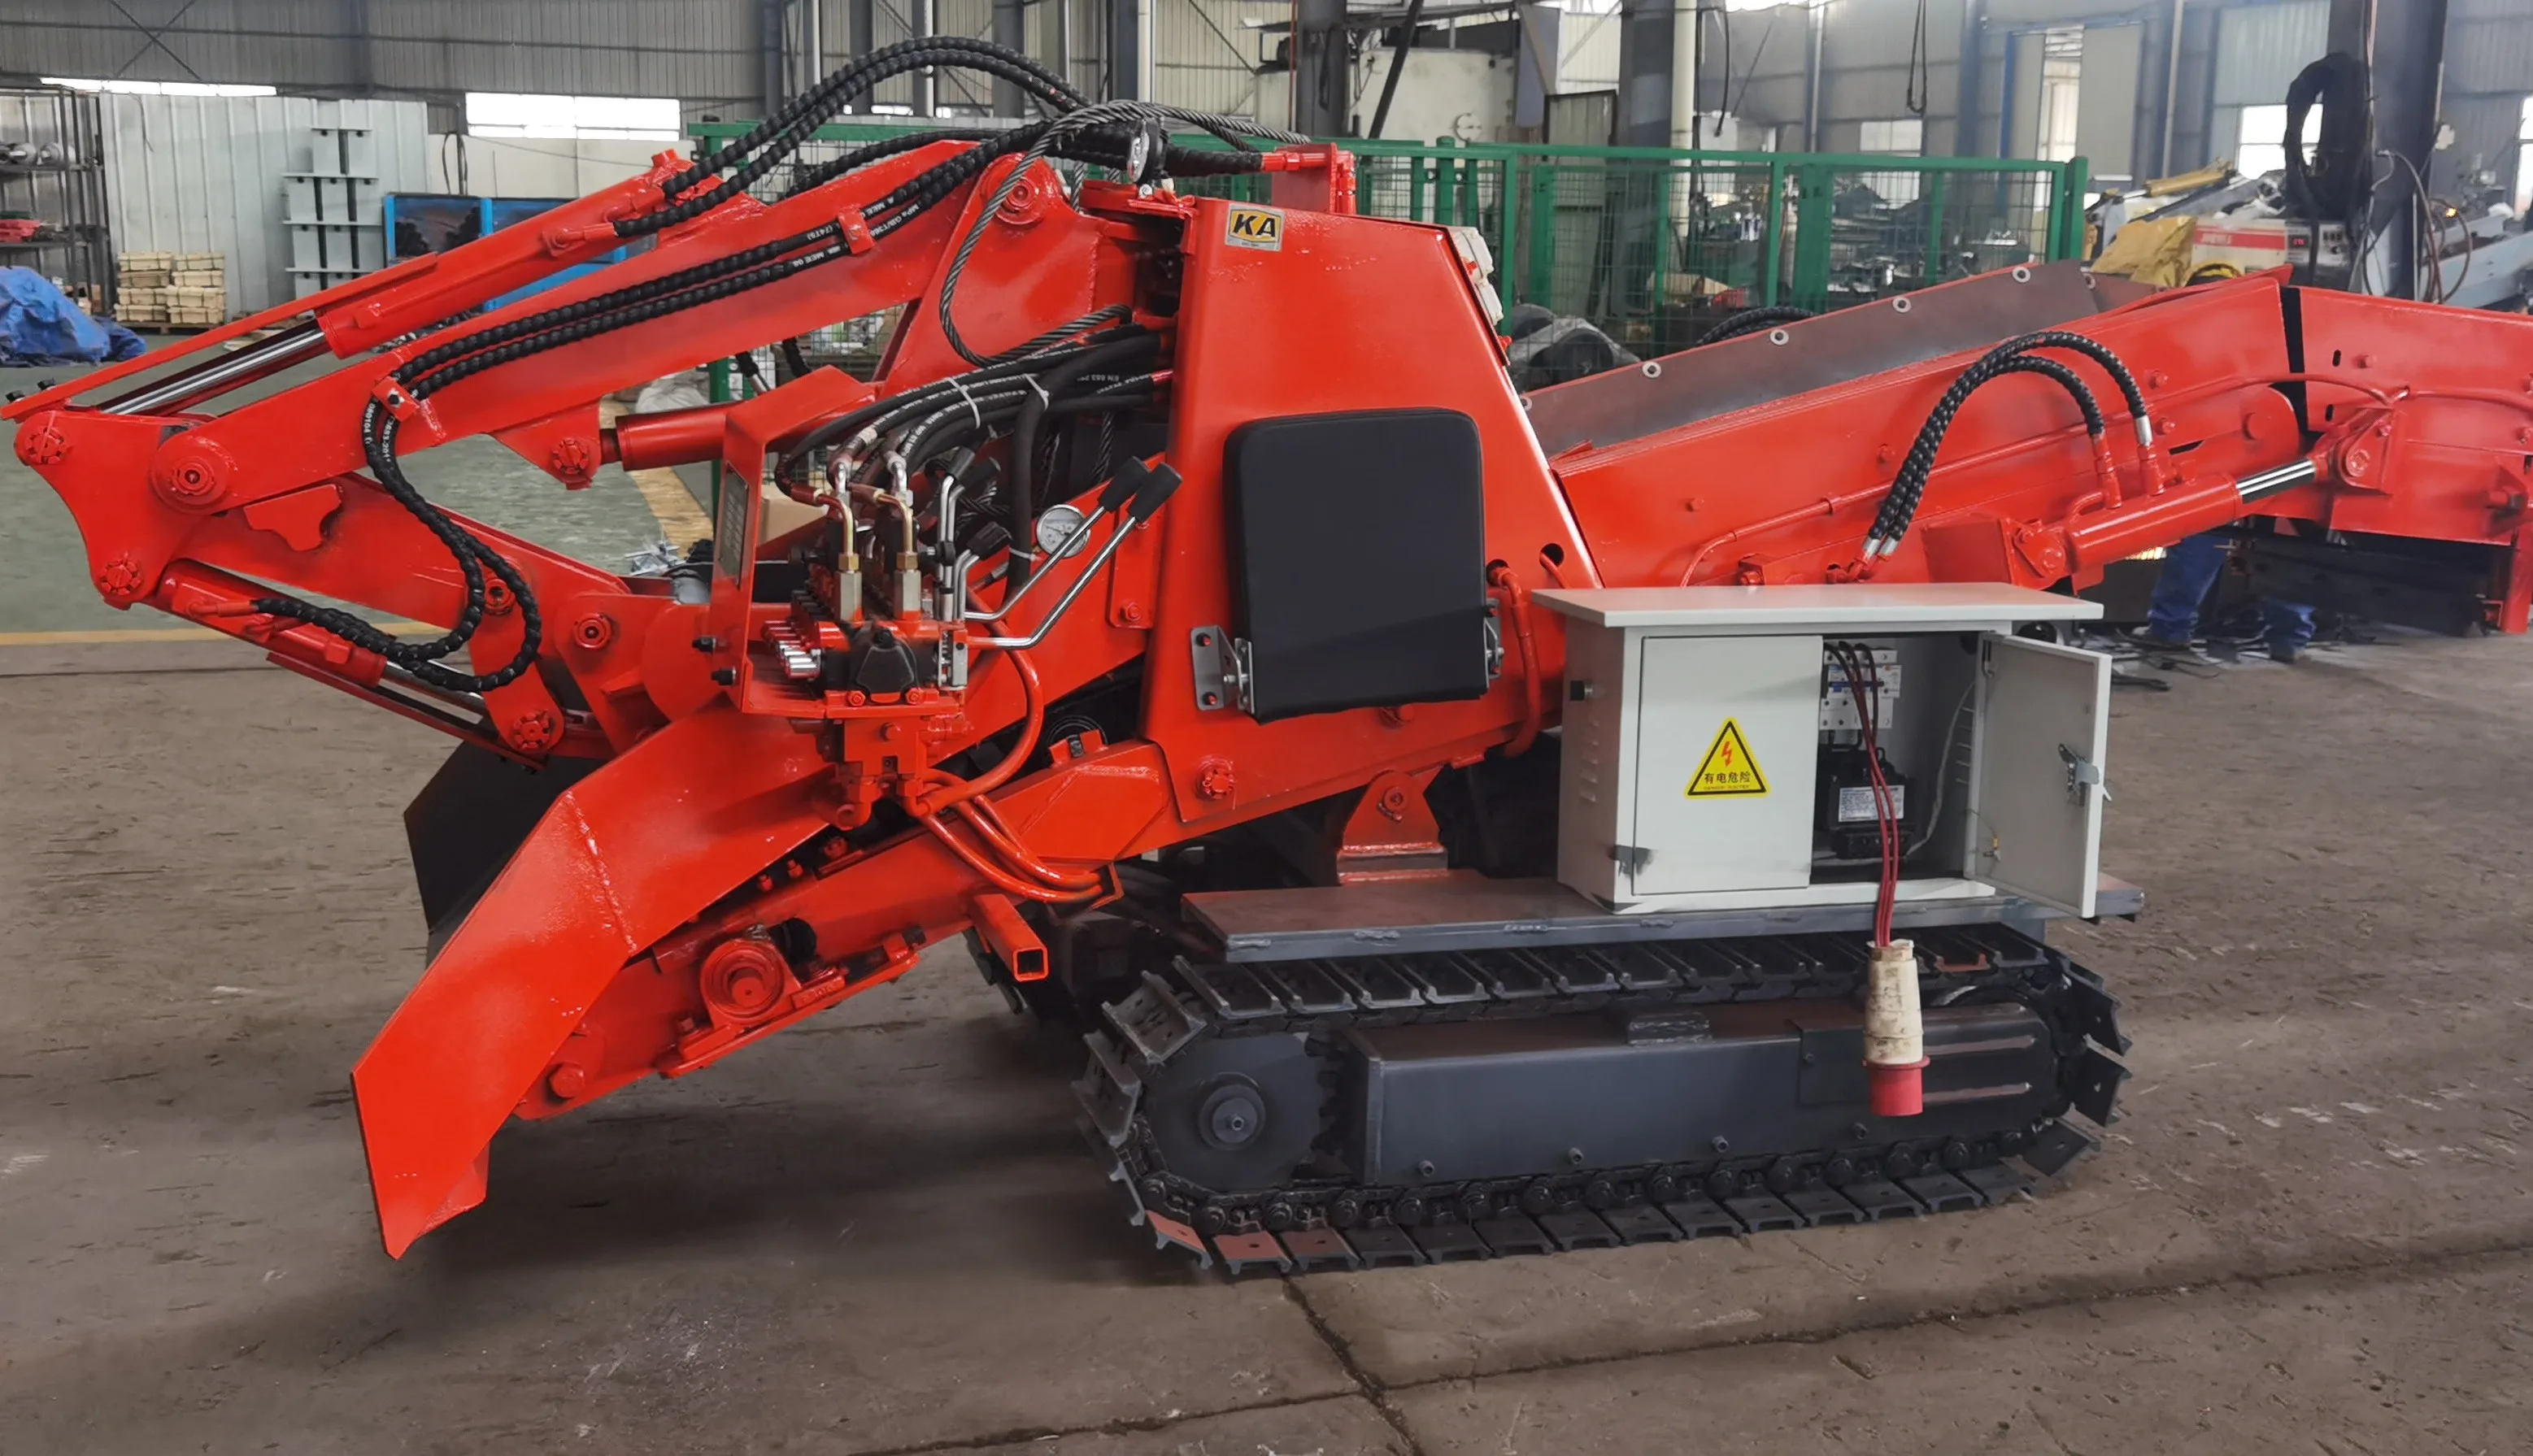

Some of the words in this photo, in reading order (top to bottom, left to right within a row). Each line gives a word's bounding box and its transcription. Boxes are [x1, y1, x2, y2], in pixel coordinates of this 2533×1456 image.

[1233, 214, 1276, 237] KA
[1704, 771, 1752, 785] 有电危险
